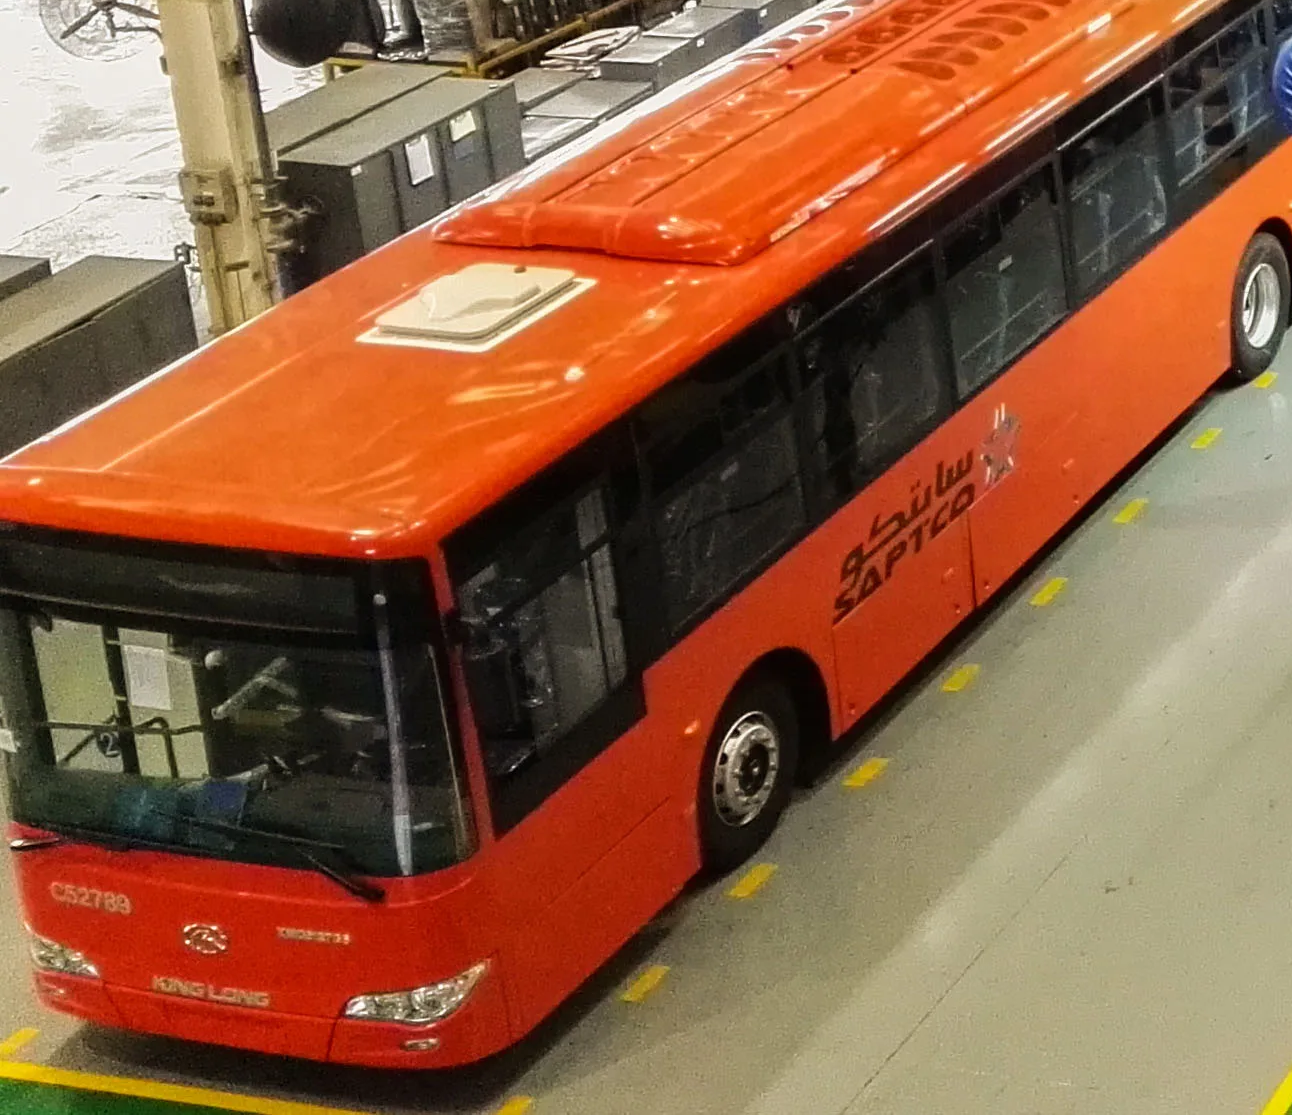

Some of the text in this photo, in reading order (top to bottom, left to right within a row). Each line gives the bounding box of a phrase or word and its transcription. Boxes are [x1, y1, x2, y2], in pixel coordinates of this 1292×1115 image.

[833, 483, 975, 625] SAPTCO
[153, 975, 270, 1007] KING LONG
